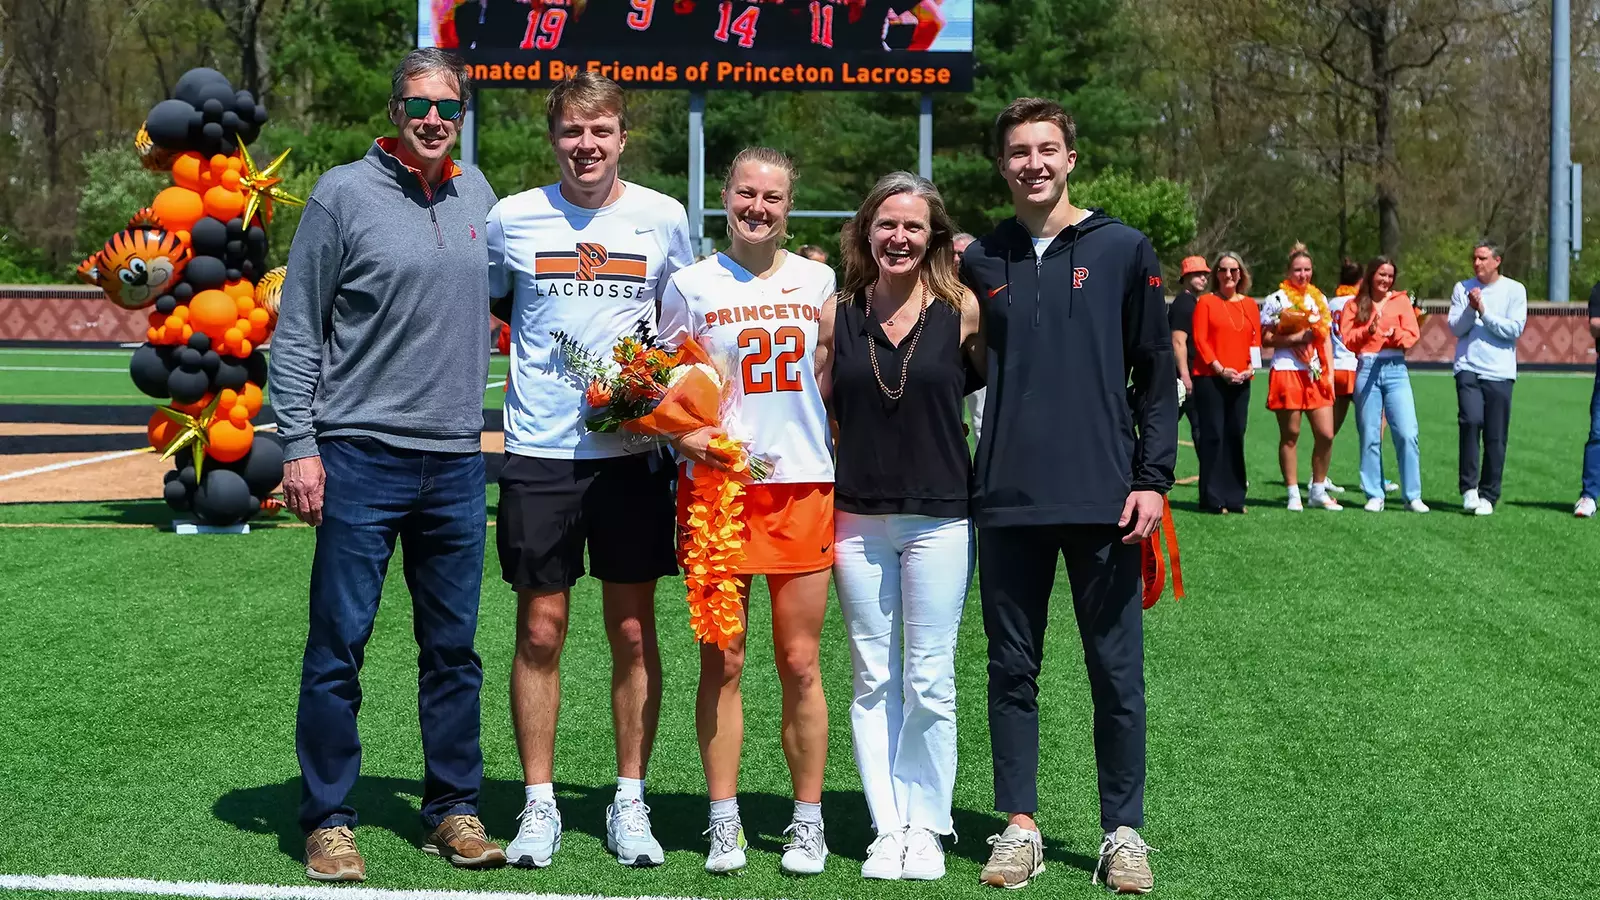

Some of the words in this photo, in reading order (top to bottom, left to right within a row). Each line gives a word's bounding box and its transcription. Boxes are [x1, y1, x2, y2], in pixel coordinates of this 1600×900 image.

[519, 8, 568, 50] 19
[714, 1, 760, 48] 14
[809, 1, 833, 48] 11
[464, 60, 541, 81] onated
[549, 60, 579, 80] By
[586, 60, 678, 81] Friends
[685, 61, 709, 82] of
[717, 61, 834, 83] Princeton
[842, 62, 951, 84] Lacrosse
[575, 242, 608, 281] P
[1072, 266, 1090, 289] P
[535, 282, 646, 299] LACROSSE
[704, 303, 820, 328] PRINCETON
[737, 326, 806, 395] 22
